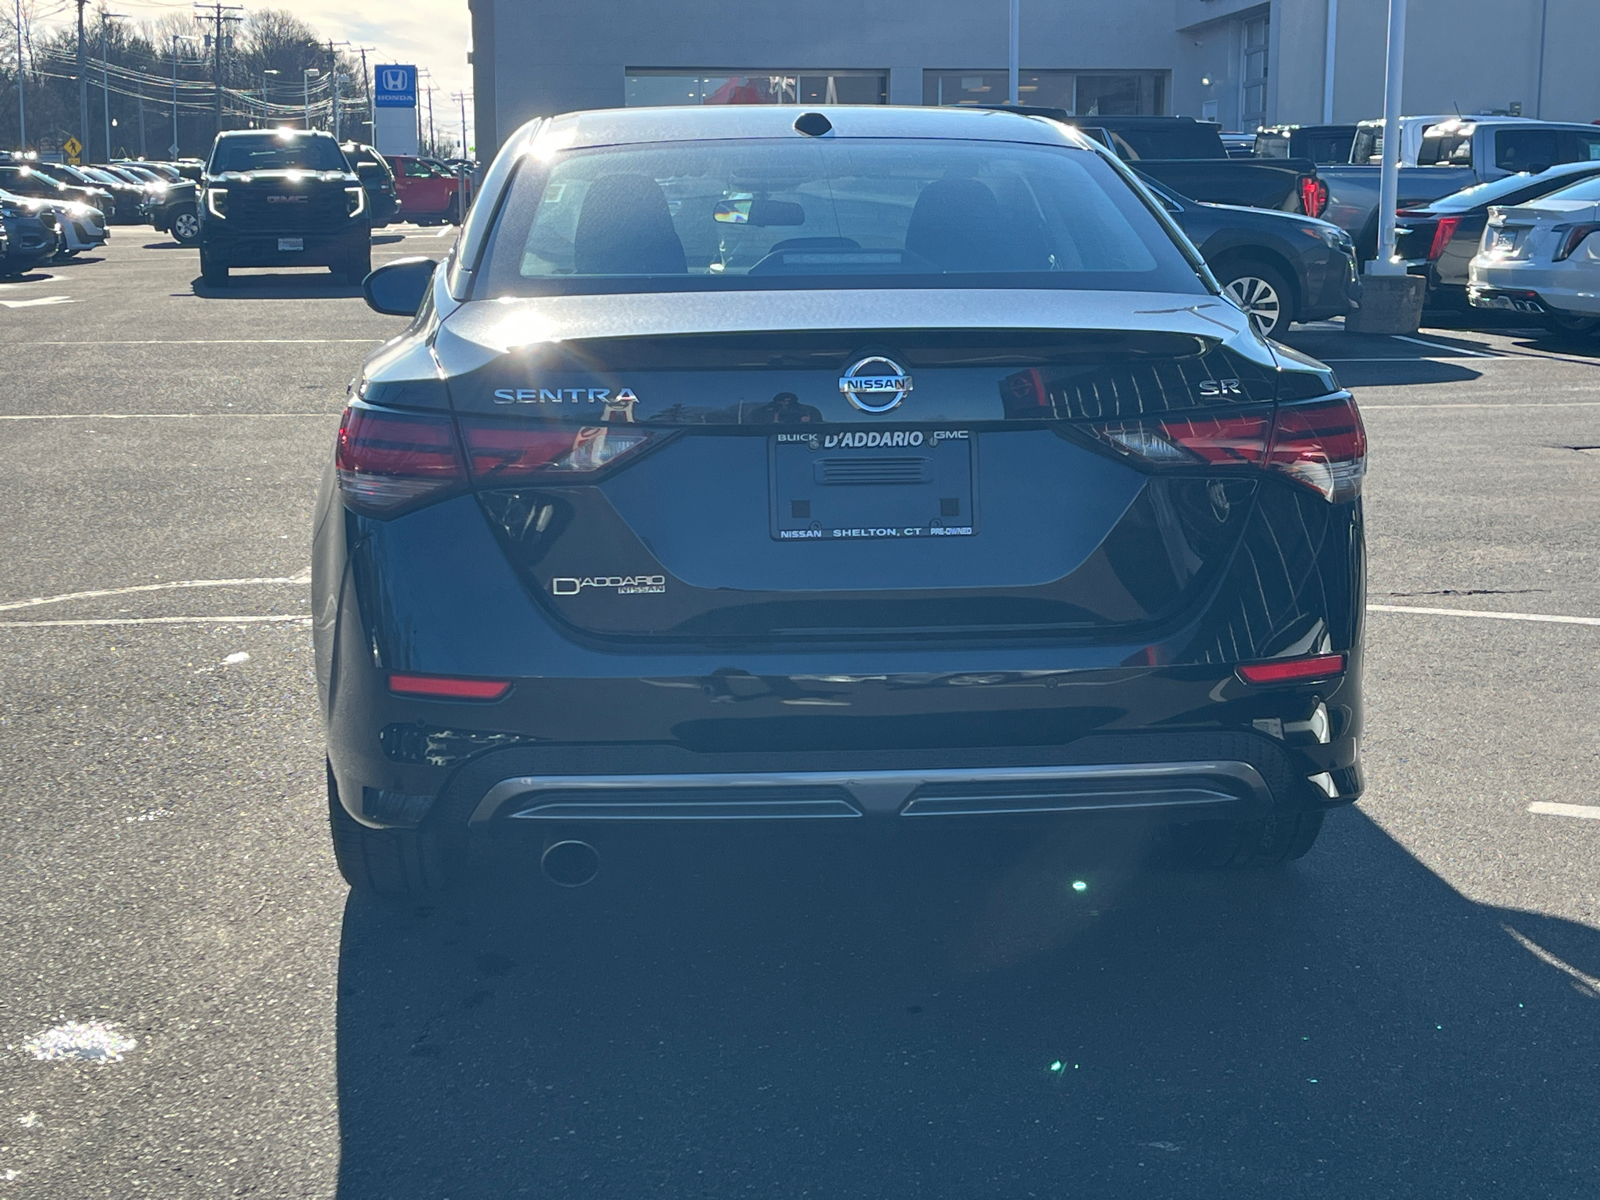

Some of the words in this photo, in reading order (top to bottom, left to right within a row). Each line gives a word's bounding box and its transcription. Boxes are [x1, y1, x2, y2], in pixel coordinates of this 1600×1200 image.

[267, 195, 308, 203] GMC
[847, 379, 905, 389] NISSAN
[1199, 378, 1241, 396] SR
[493, 388, 640, 404] SENTRA
[777, 433, 818, 442] BUICK
[824, 431, 924, 448] D'ADDARIO
[934, 430, 969, 439] GMC
[780, 530, 822, 538] NISSAN
[833, 528, 900, 537] SHELTON,
[903, 527, 922, 536] CT
[930, 527, 972, 536] PRE-OWNED
[553, 575, 666, 595] D'ADDARIO
[618, 585, 666, 594] NISSAN
